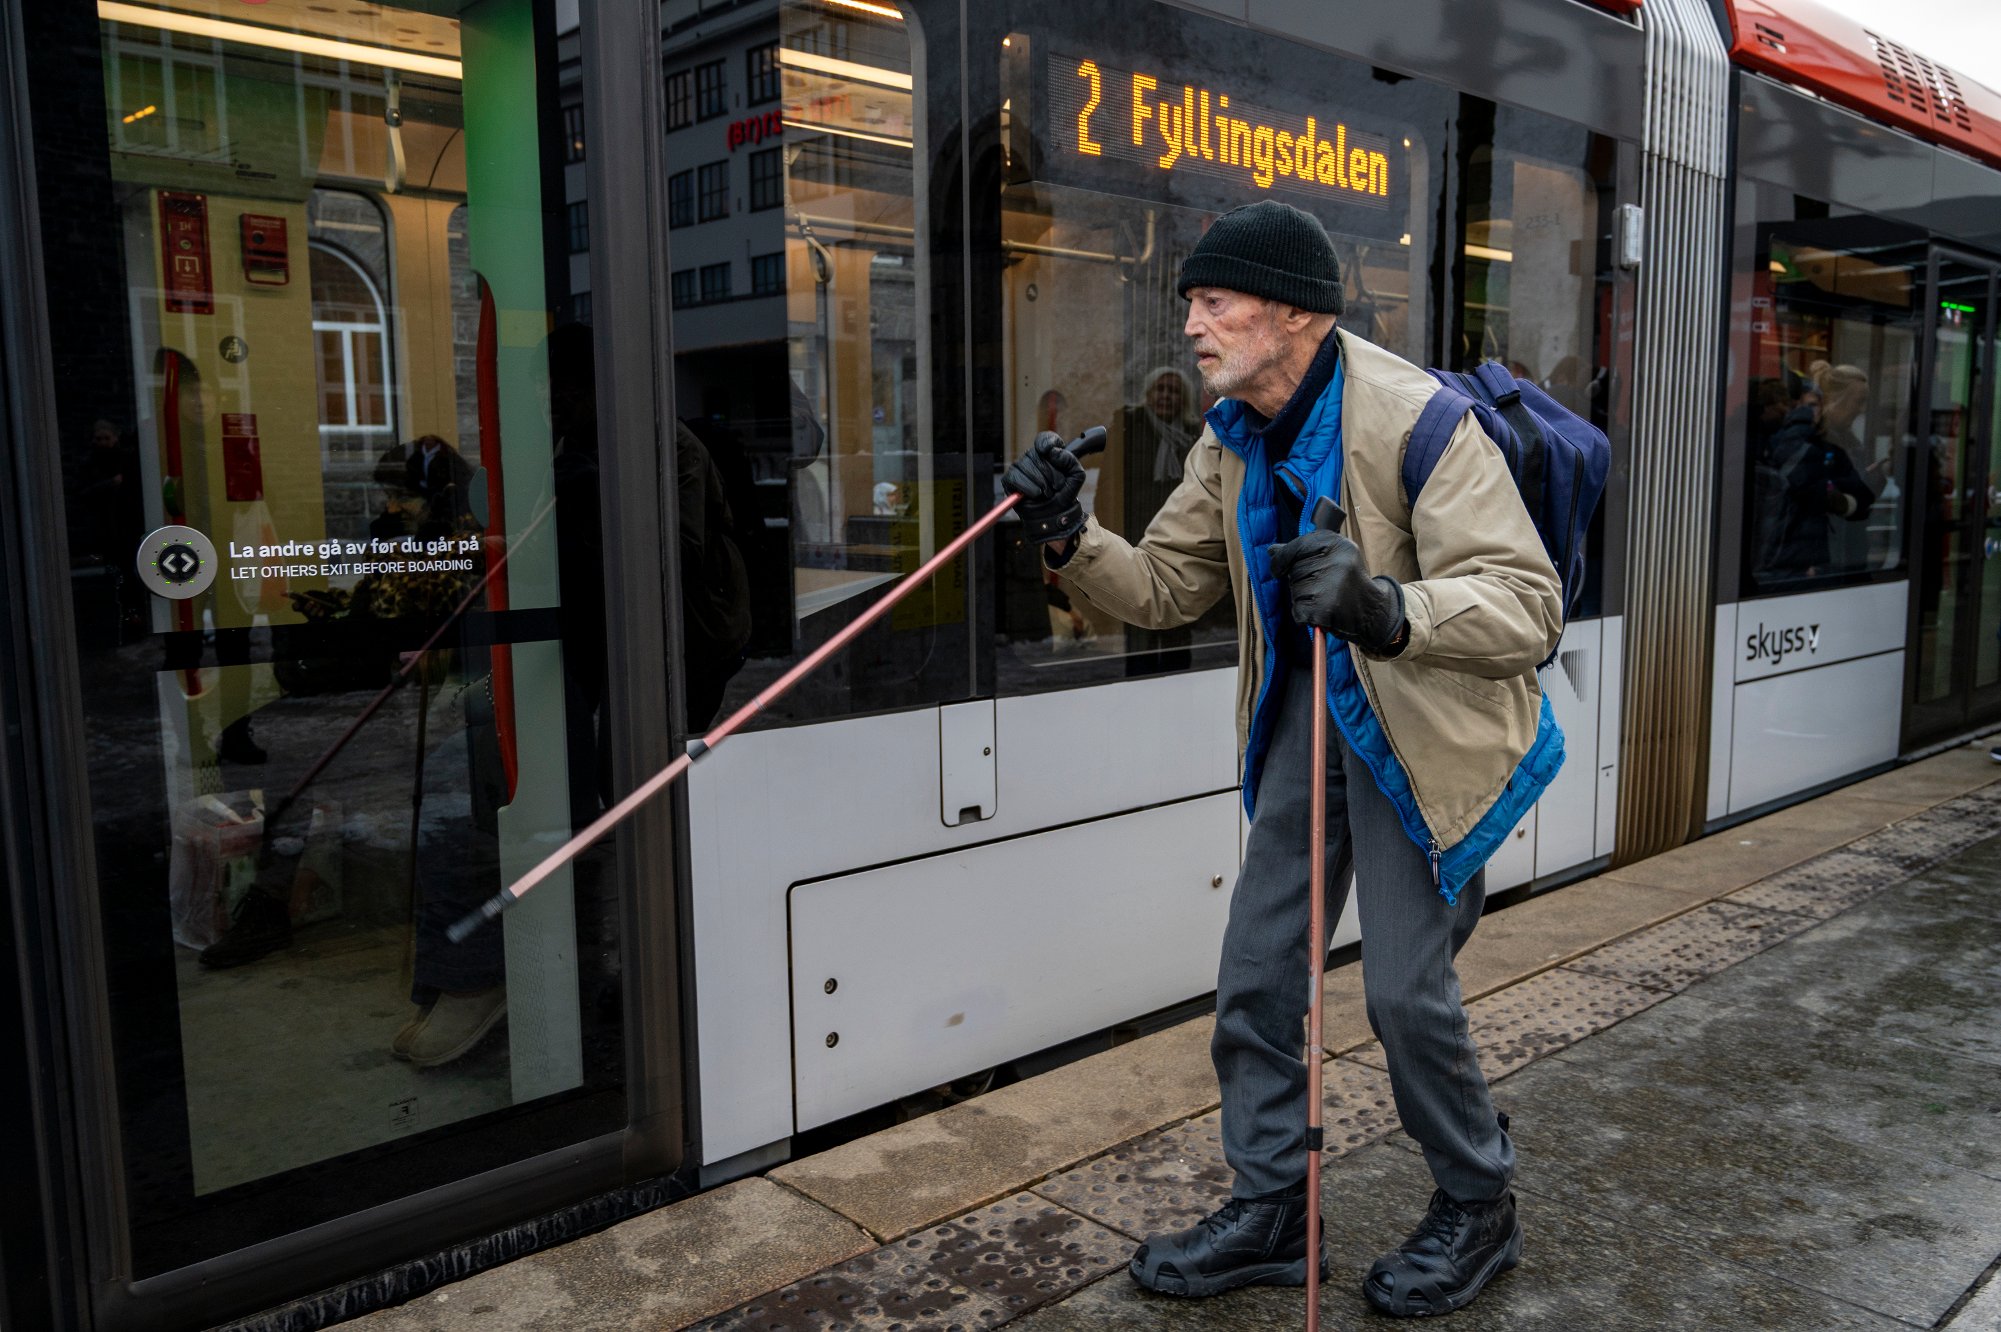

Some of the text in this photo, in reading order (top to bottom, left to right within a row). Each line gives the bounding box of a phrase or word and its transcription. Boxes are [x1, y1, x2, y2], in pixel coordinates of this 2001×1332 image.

[1078, 58, 1389, 197] 2 Fyllingsdalen
[229, 535, 479, 559] La andre gå av før du går på
[231, 559, 473, 579] LET OTHERS EXIT BEFORE BOARDING
[1746, 622, 1804, 665] skyss
